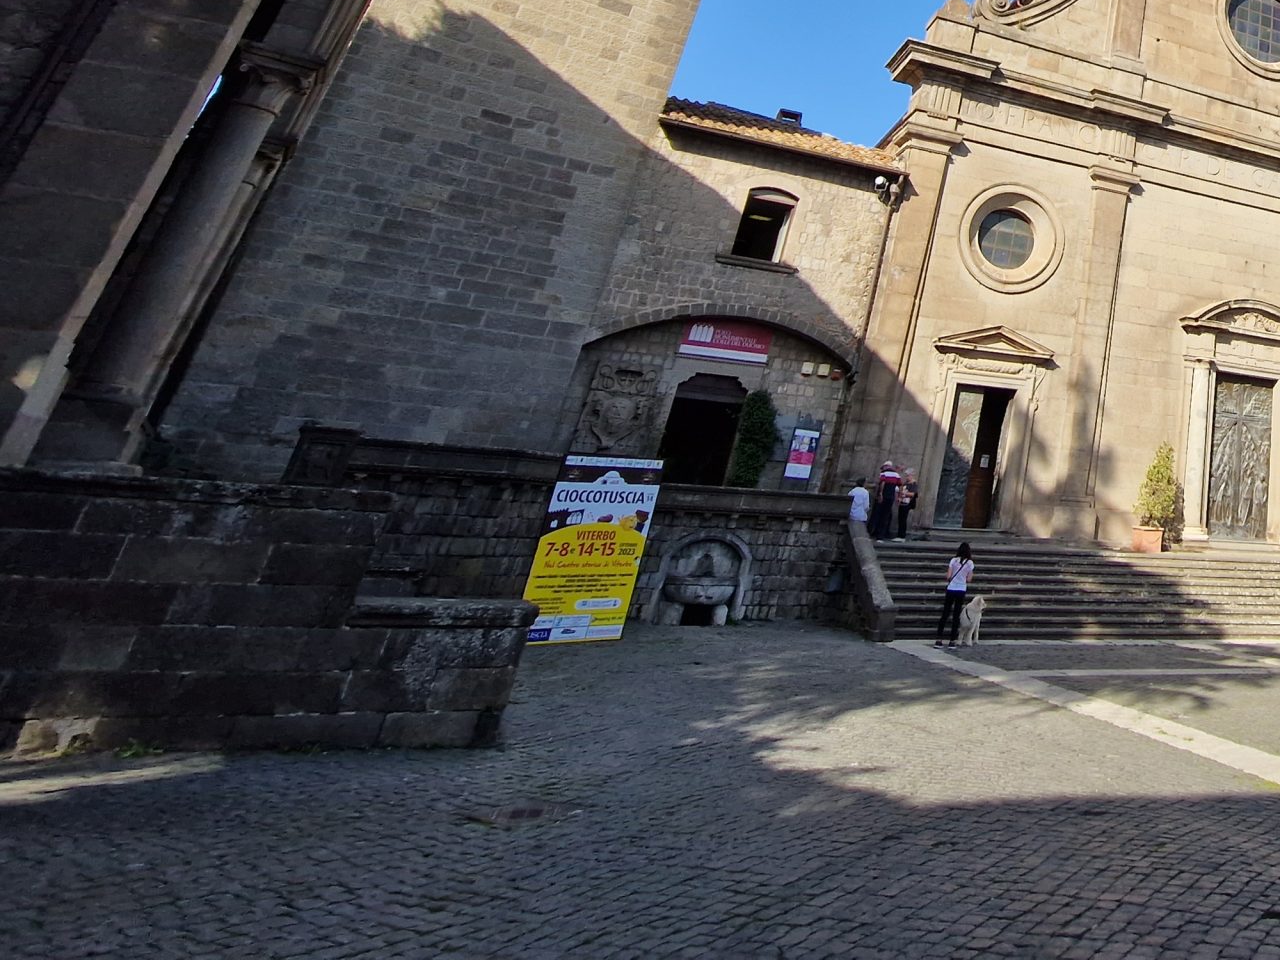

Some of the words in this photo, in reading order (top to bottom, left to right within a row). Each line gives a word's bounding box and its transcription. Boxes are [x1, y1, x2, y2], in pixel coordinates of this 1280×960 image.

[556, 489, 645, 504] CIOCCOTUSCIA
[576, 530, 616, 541] VITERBO
[545, 542, 570, 557] 7-8
[577, 542, 616, 557] 14-15
[618, 547, 636, 556] 2023
